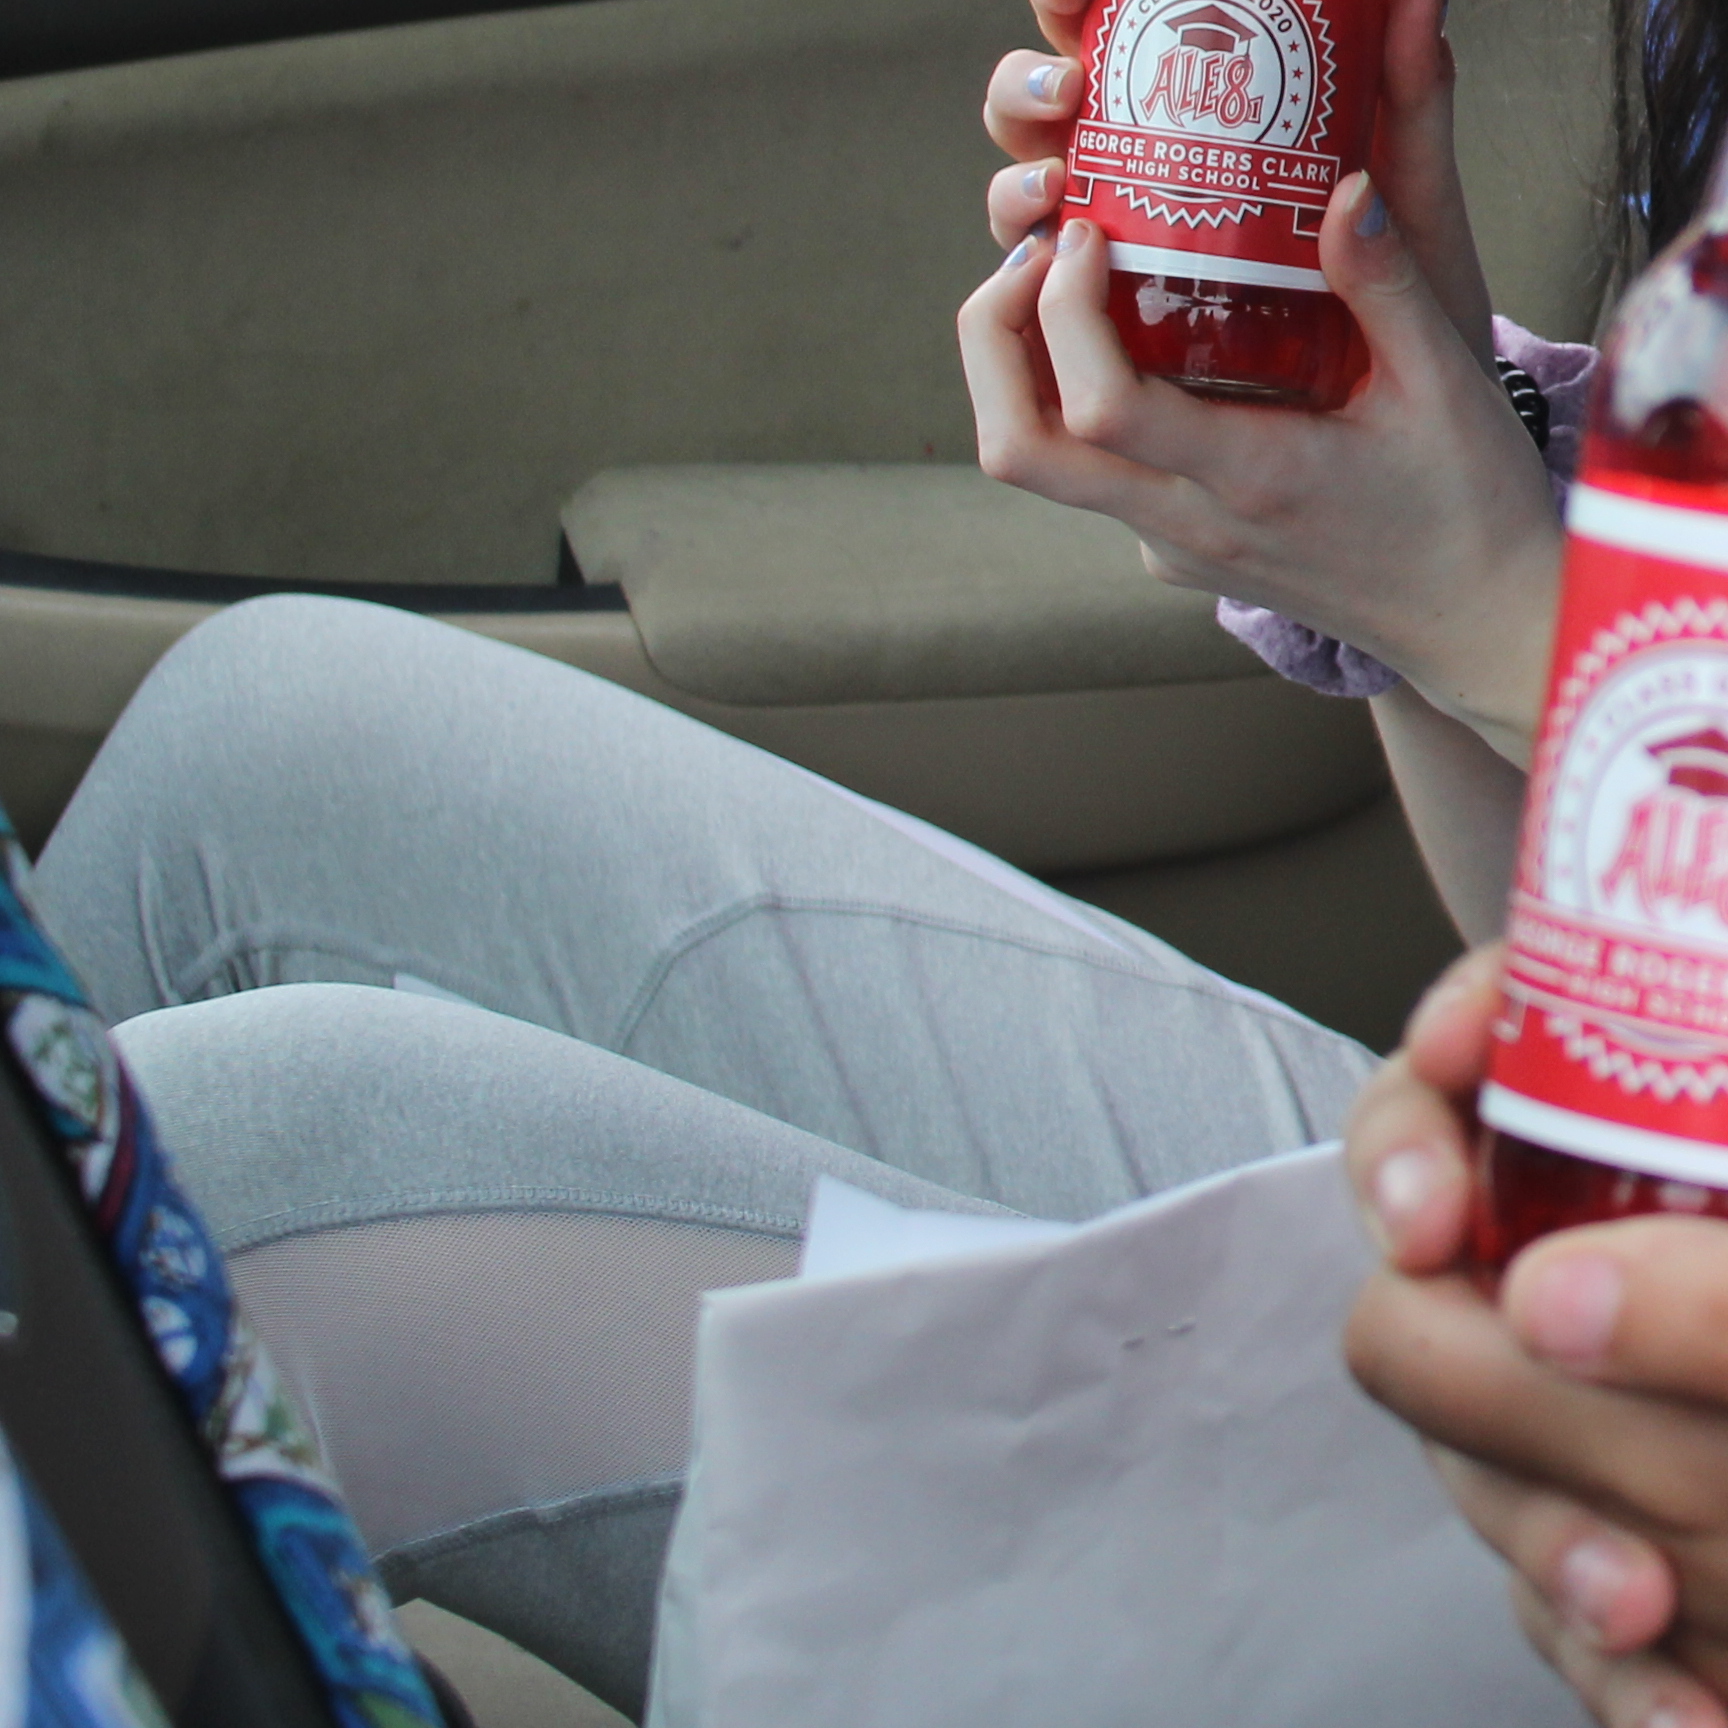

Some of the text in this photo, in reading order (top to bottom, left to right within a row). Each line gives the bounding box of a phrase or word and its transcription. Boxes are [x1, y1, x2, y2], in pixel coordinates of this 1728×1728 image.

[1079, 129, 1331, 183] GEORGE ROGERS CLARK
[1126, 158, 1260, 191] HIGH SCHOOL
